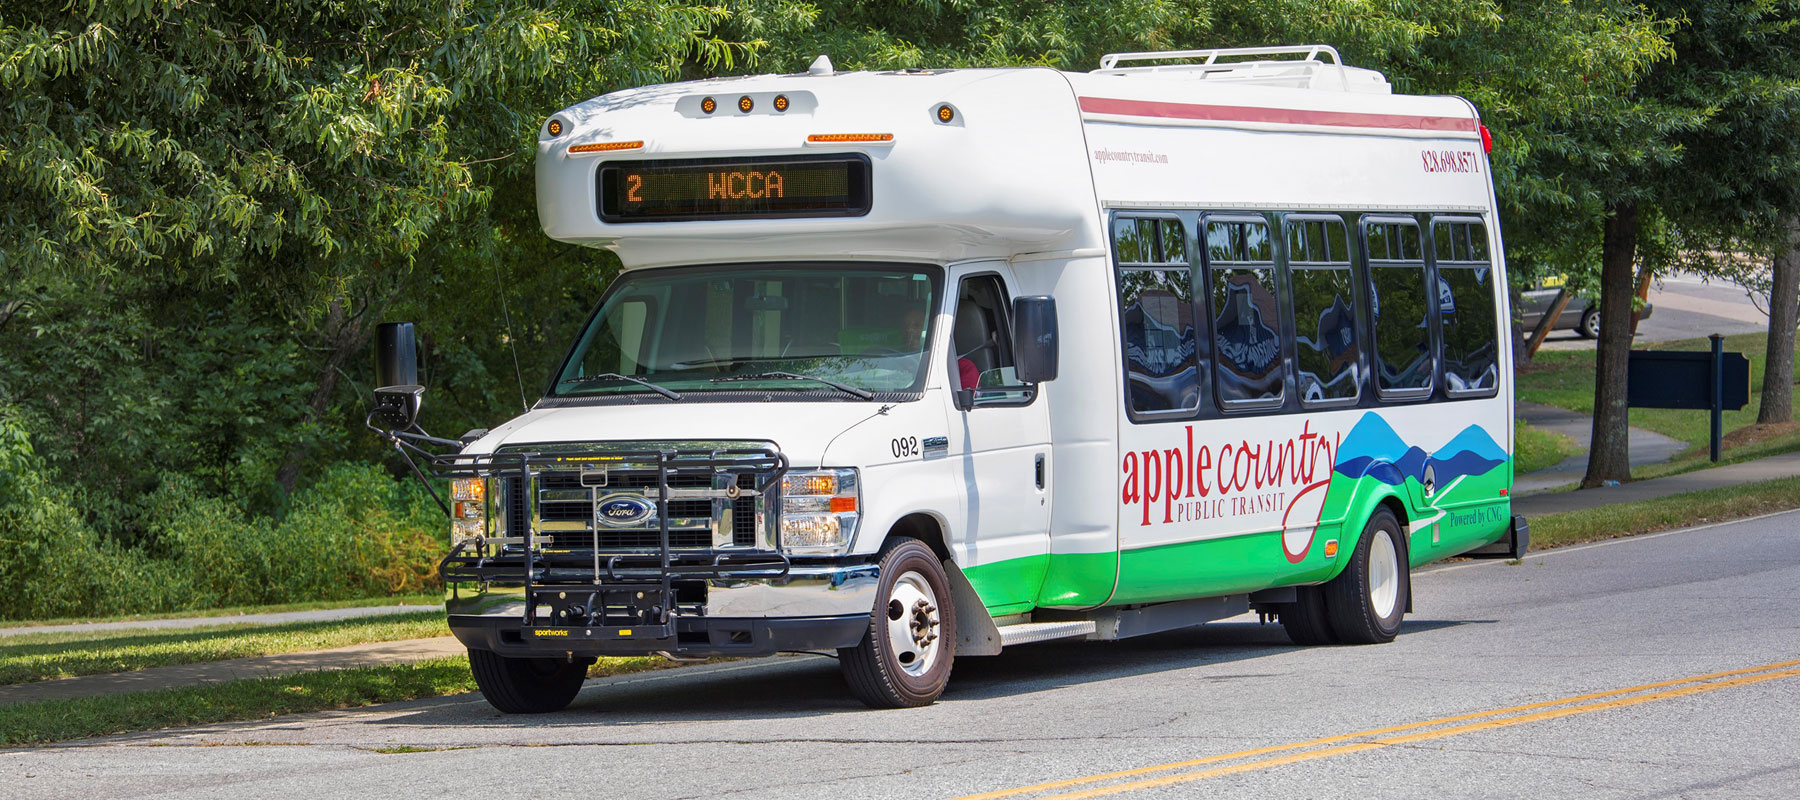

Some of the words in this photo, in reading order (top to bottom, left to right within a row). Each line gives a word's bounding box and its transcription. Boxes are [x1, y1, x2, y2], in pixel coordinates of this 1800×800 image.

[1094, 147, 1169, 165] applecountrytransit.com
[1421, 150, 1479, 173] 828.698.8571
[626, 174, 642, 202] 2
[708, 170, 784, 200] WCCA
[891, 435, 919, 458] 092
[1122, 425, 1213, 526] apple
[1217, 419, 1340, 564] country
[608, 503, 636, 516] Ford
[1177, 498, 1225, 523] PUBLIC
[1231, 492, 1285, 517] TRANSIT
[1450, 509, 1477, 528] Powered
[1477, 508, 1486, 528] by
[1486, 505, 1502, 523] CNG
[534, 629, 568, 637] sportworks
